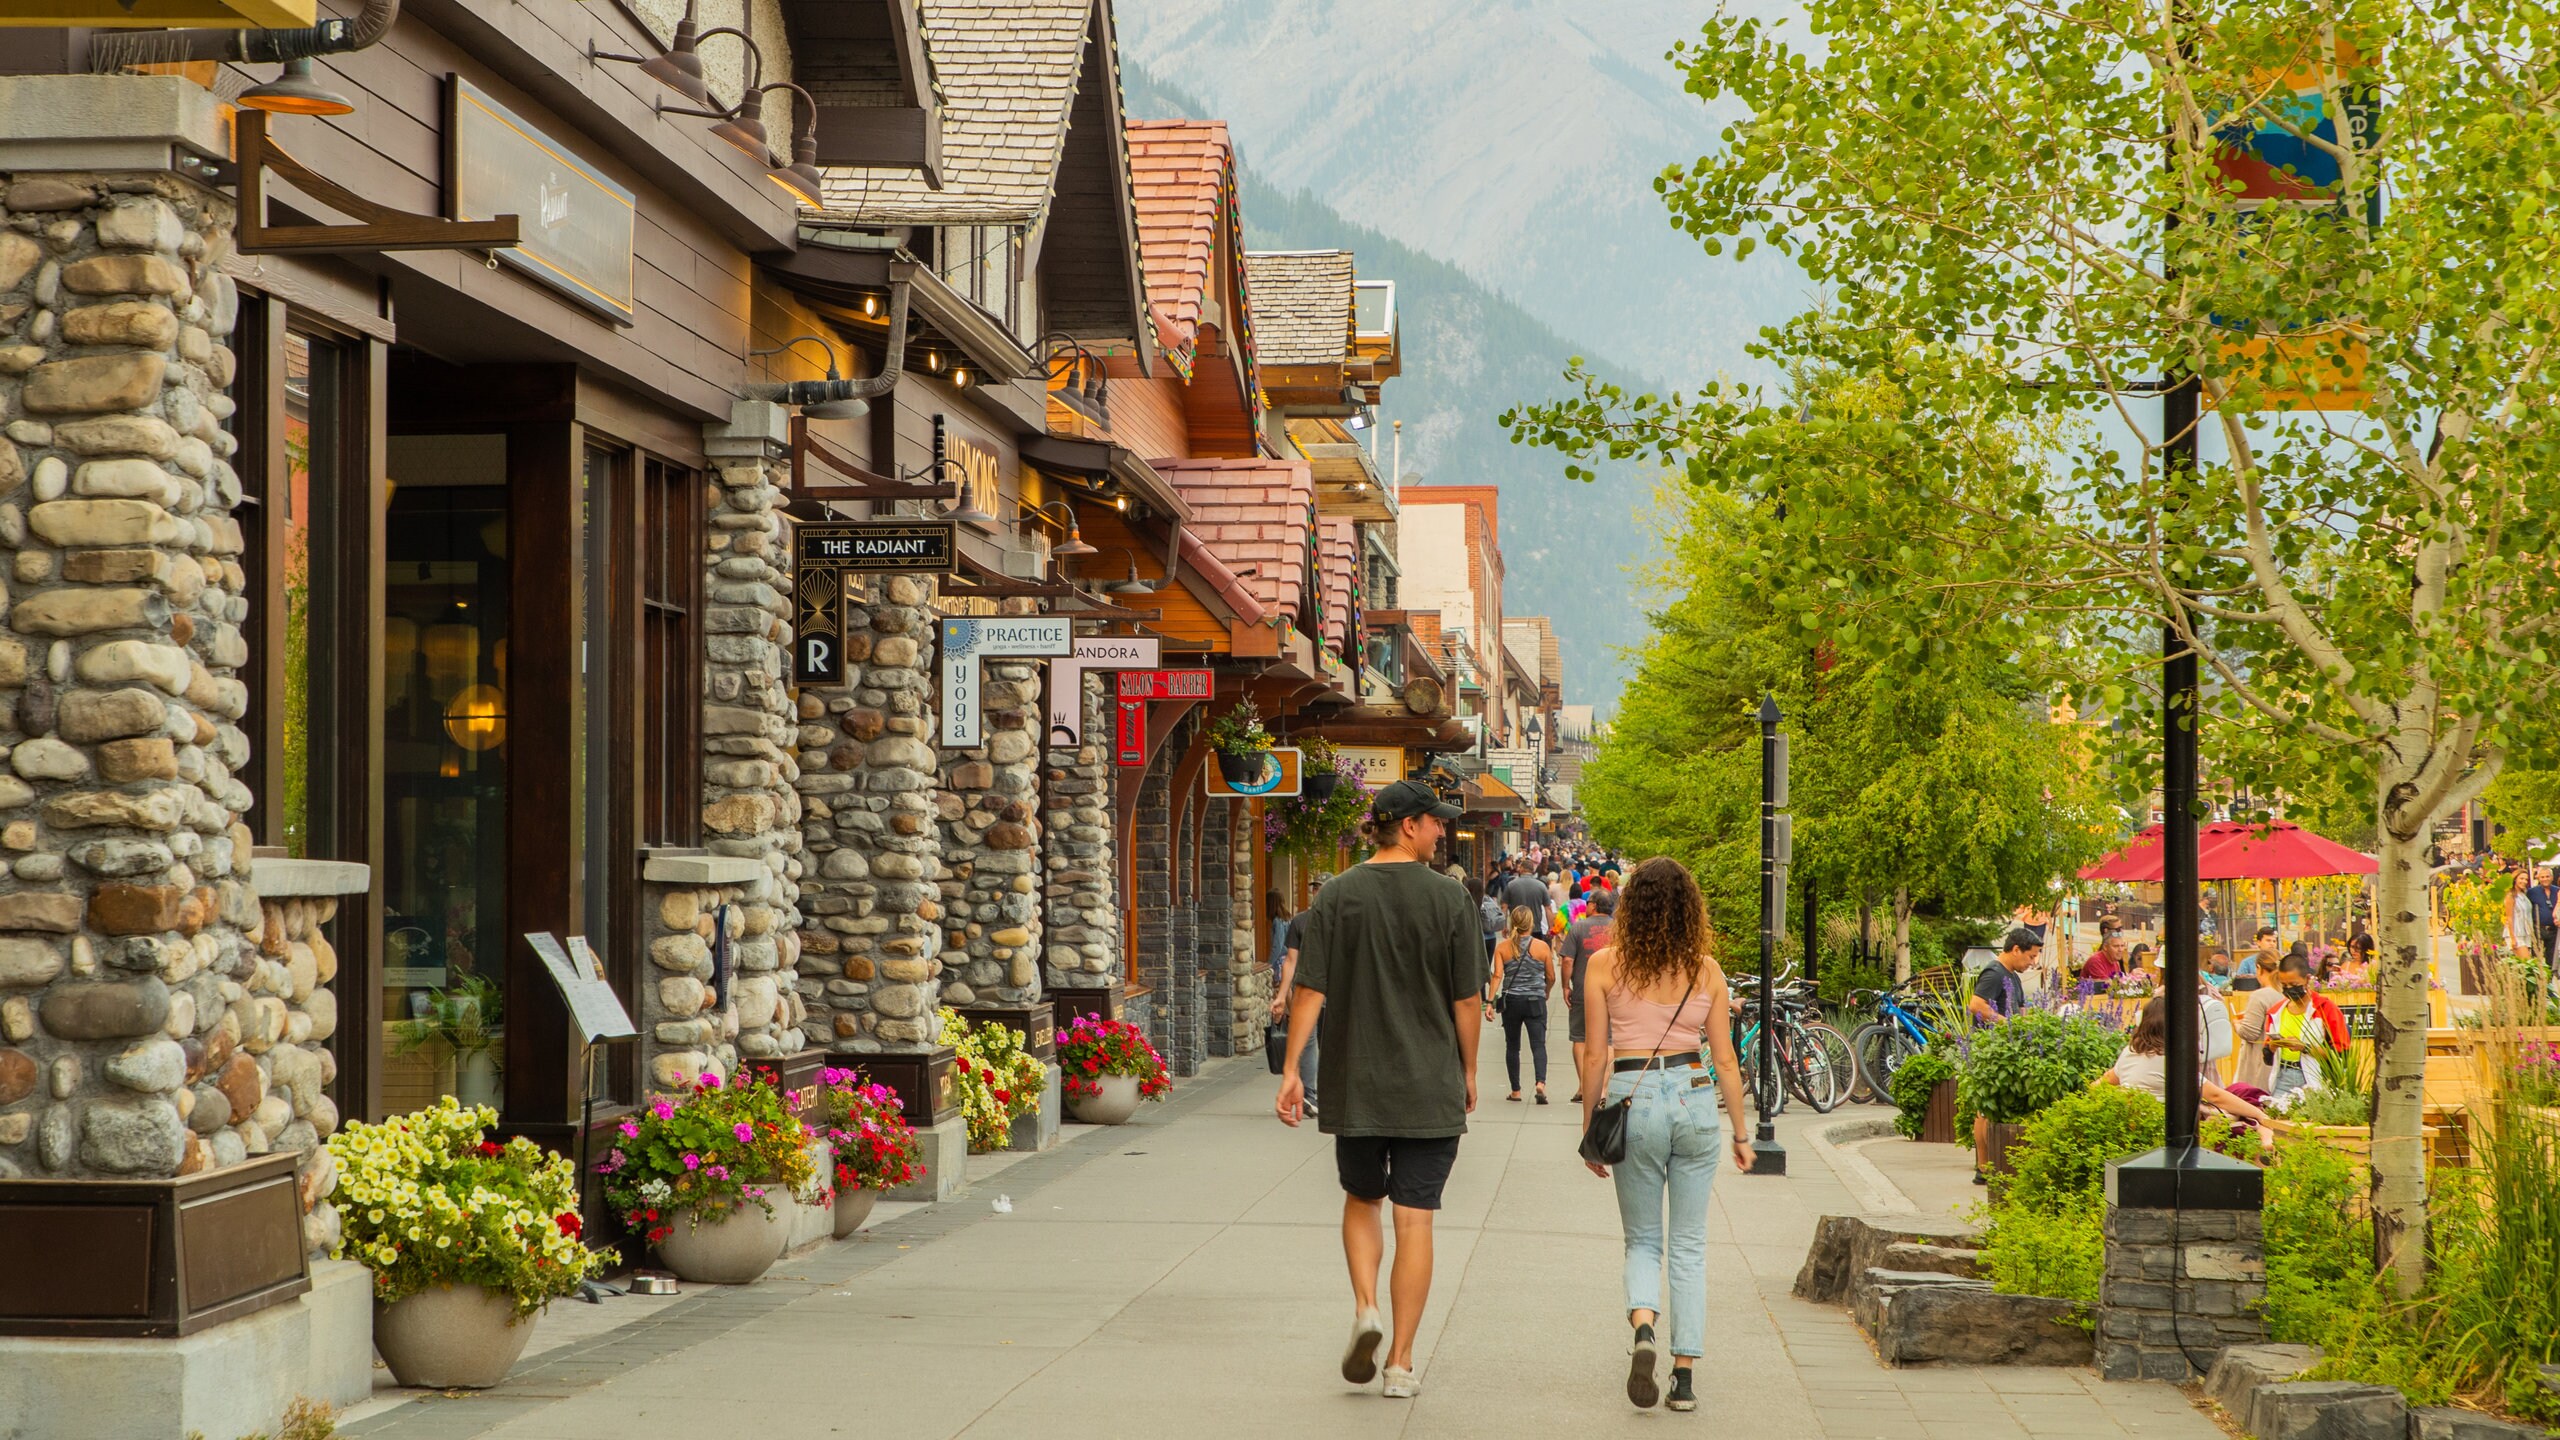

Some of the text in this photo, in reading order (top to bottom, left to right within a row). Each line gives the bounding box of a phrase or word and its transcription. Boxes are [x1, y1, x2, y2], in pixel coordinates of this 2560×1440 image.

[822, 539, 927, 555] THE RADIANT
[986, 628, 1063, 641] PRACTICE
[807, 639, 829, 672] R
[1074, 647, 1140, 659] ANDORA
[1120, 673, 1208, 696] SALON BARBER
[954, 664, 967, 738] yoga
[1360, 758, 1387, 767] KEG
[2343, 1013, 2375, 1024] THE
